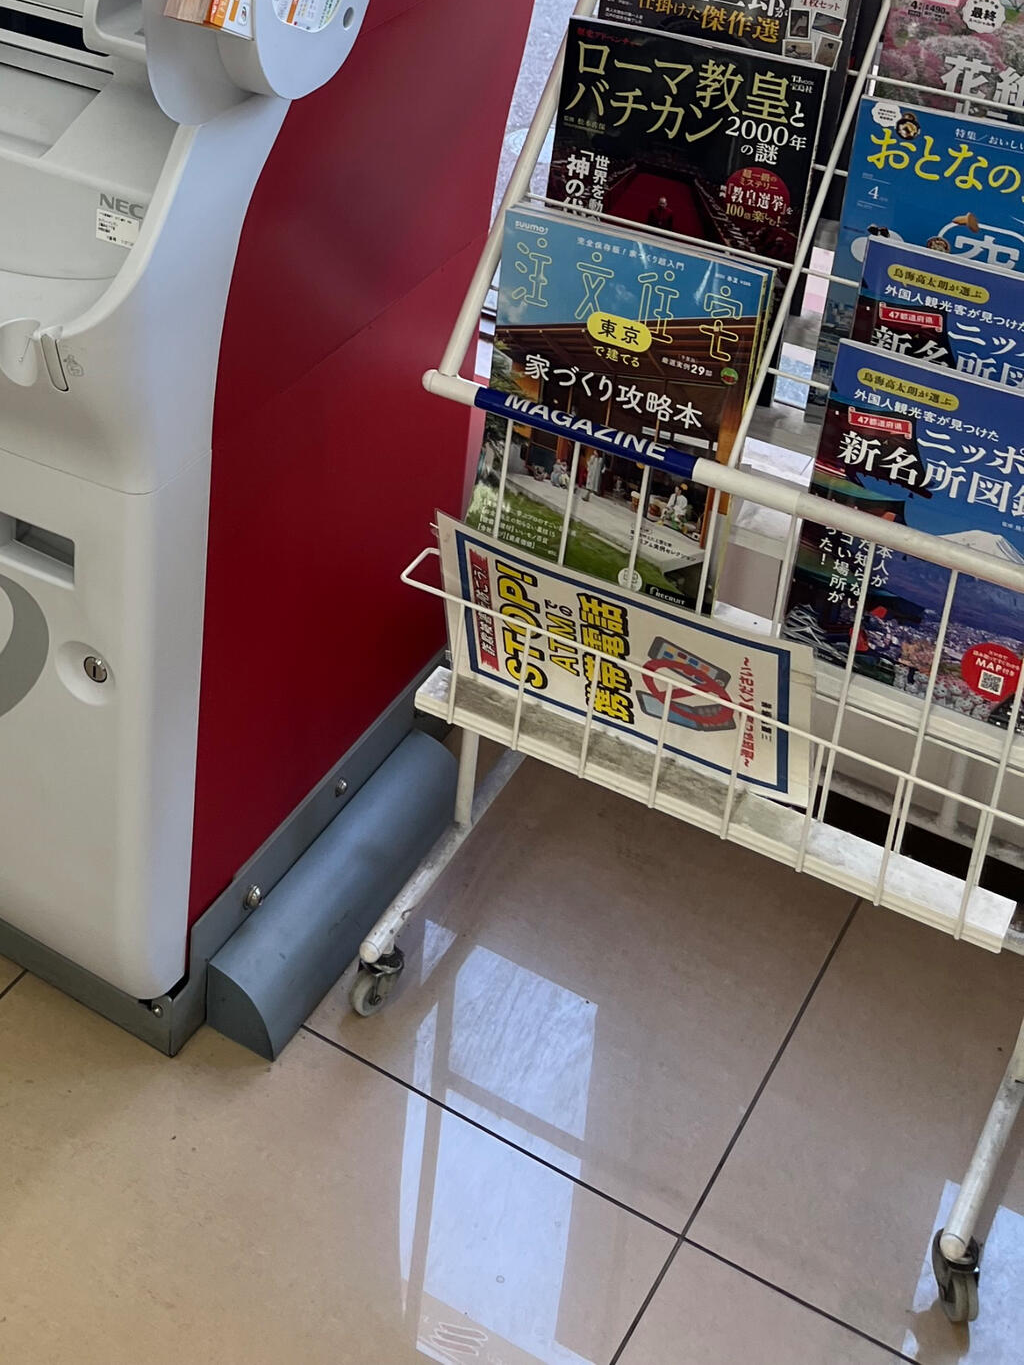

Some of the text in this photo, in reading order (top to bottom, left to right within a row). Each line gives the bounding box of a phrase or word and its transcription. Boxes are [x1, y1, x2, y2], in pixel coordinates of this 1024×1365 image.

[566, 81, 723, 143] バチカン
[100, 193, 144, 220] NEC
[593, 344, 640, 369] で建てる
[598, 318, 642, 346] 東京
[525, 353, 702, 430] 家づくり攻略本
[854, 388, 1000, 442] 外国人観光客が見つけた
[505, 393, 667, 462] MAGAZINE
[495, 560, 548, 691] STOP!
[577, 592, 634, 725] 携帯電話
